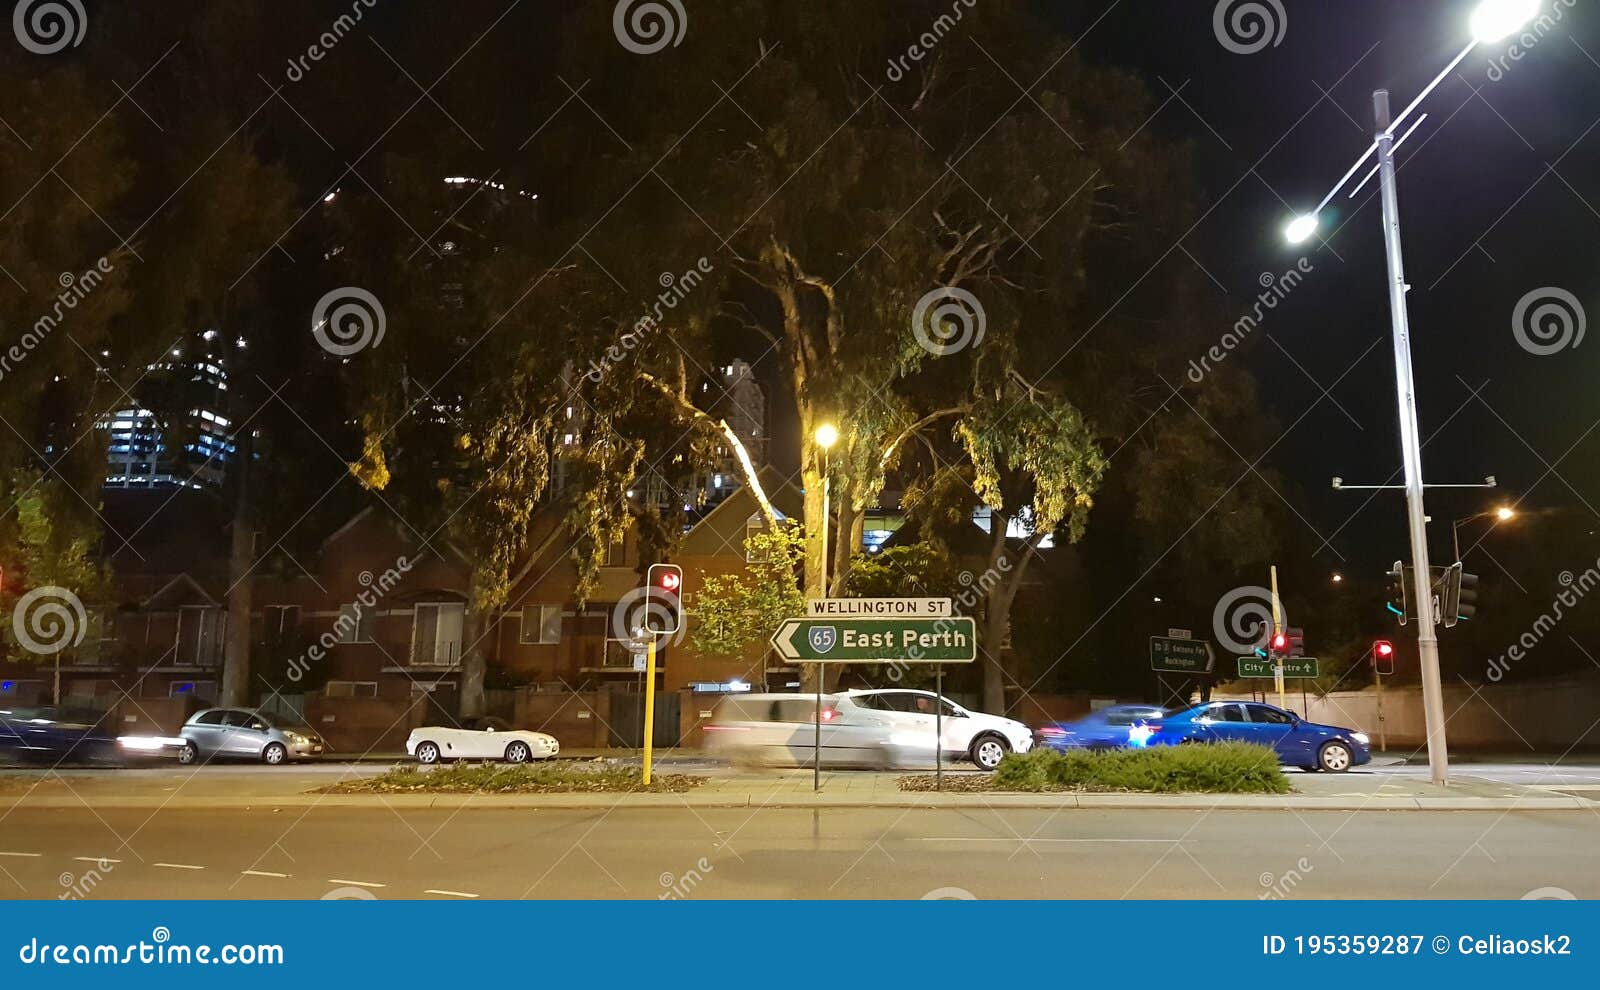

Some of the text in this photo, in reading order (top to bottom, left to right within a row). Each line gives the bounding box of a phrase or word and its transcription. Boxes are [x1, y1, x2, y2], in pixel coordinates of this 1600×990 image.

[814, 601, 946, 613] WELLINGTON ST
[813, 629, 966, 648] 65 East Perth
[1244, 663, 1301, 673] City Cntre
